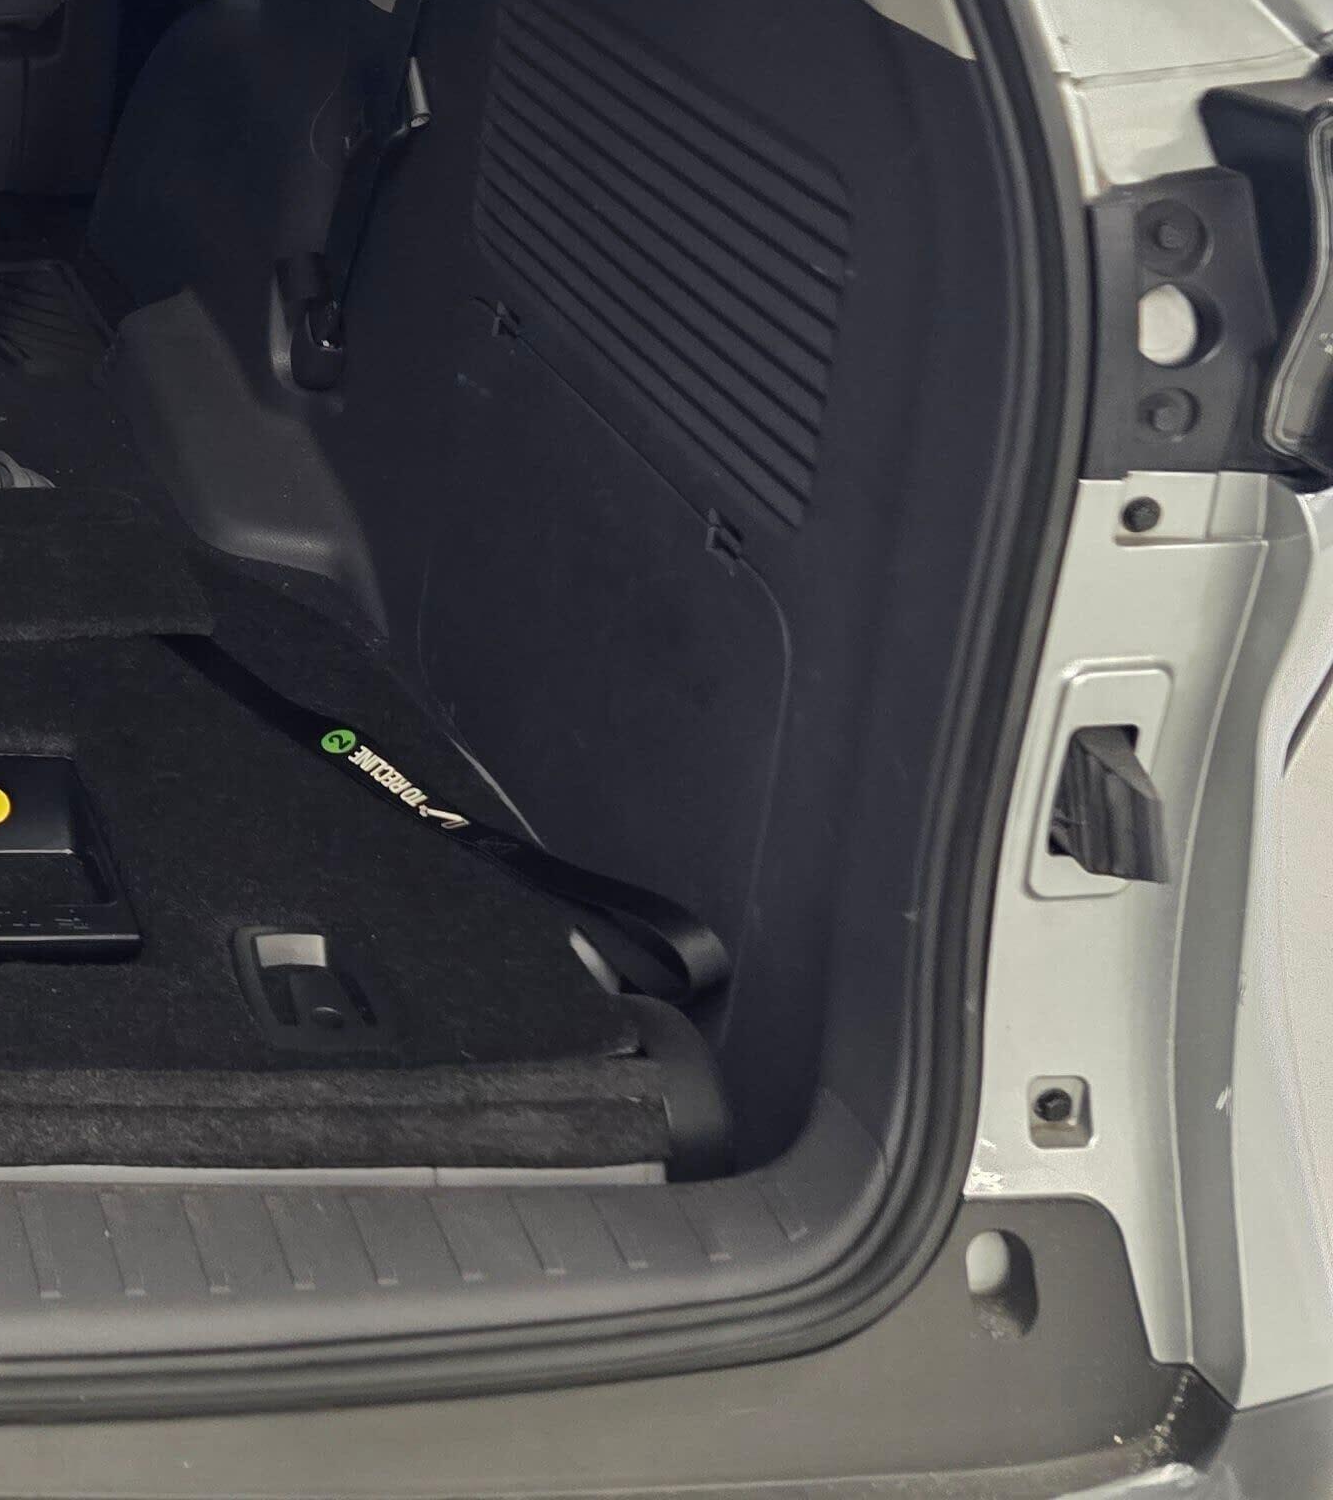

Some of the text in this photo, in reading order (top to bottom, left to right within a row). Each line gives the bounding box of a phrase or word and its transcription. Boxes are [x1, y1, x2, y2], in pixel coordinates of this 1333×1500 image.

[328, 734, 351, 750] 2
[347, 744, 429, 808] TO RECLINE
